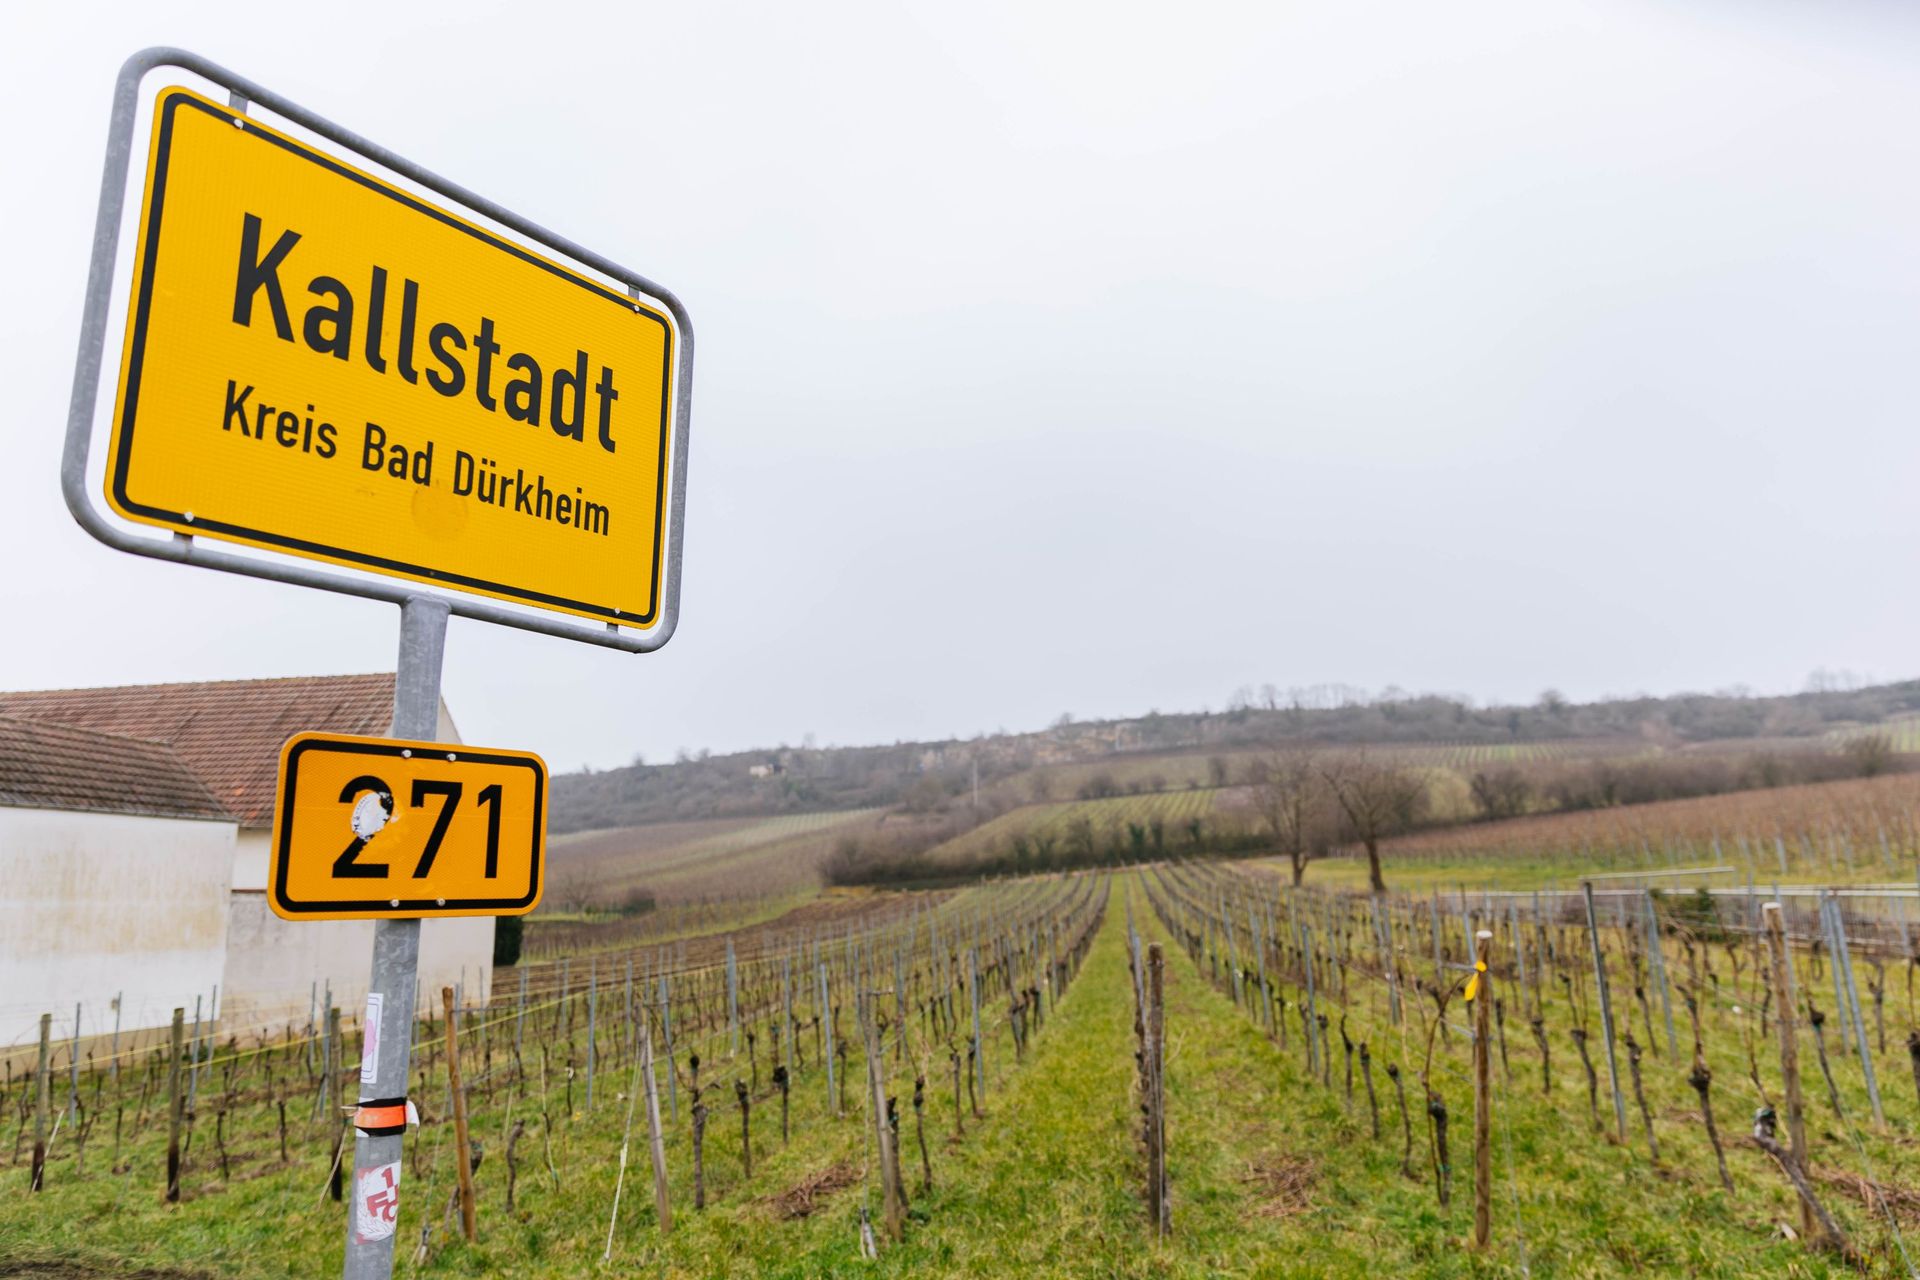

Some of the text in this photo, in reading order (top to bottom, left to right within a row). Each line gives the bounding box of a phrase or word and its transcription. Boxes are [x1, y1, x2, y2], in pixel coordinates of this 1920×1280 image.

[232, 212, 619, 454] Kallstadt
[222, 379, 610, 537] Kreis Bad Dürkheim
[331, 775, 503, 879] 271
